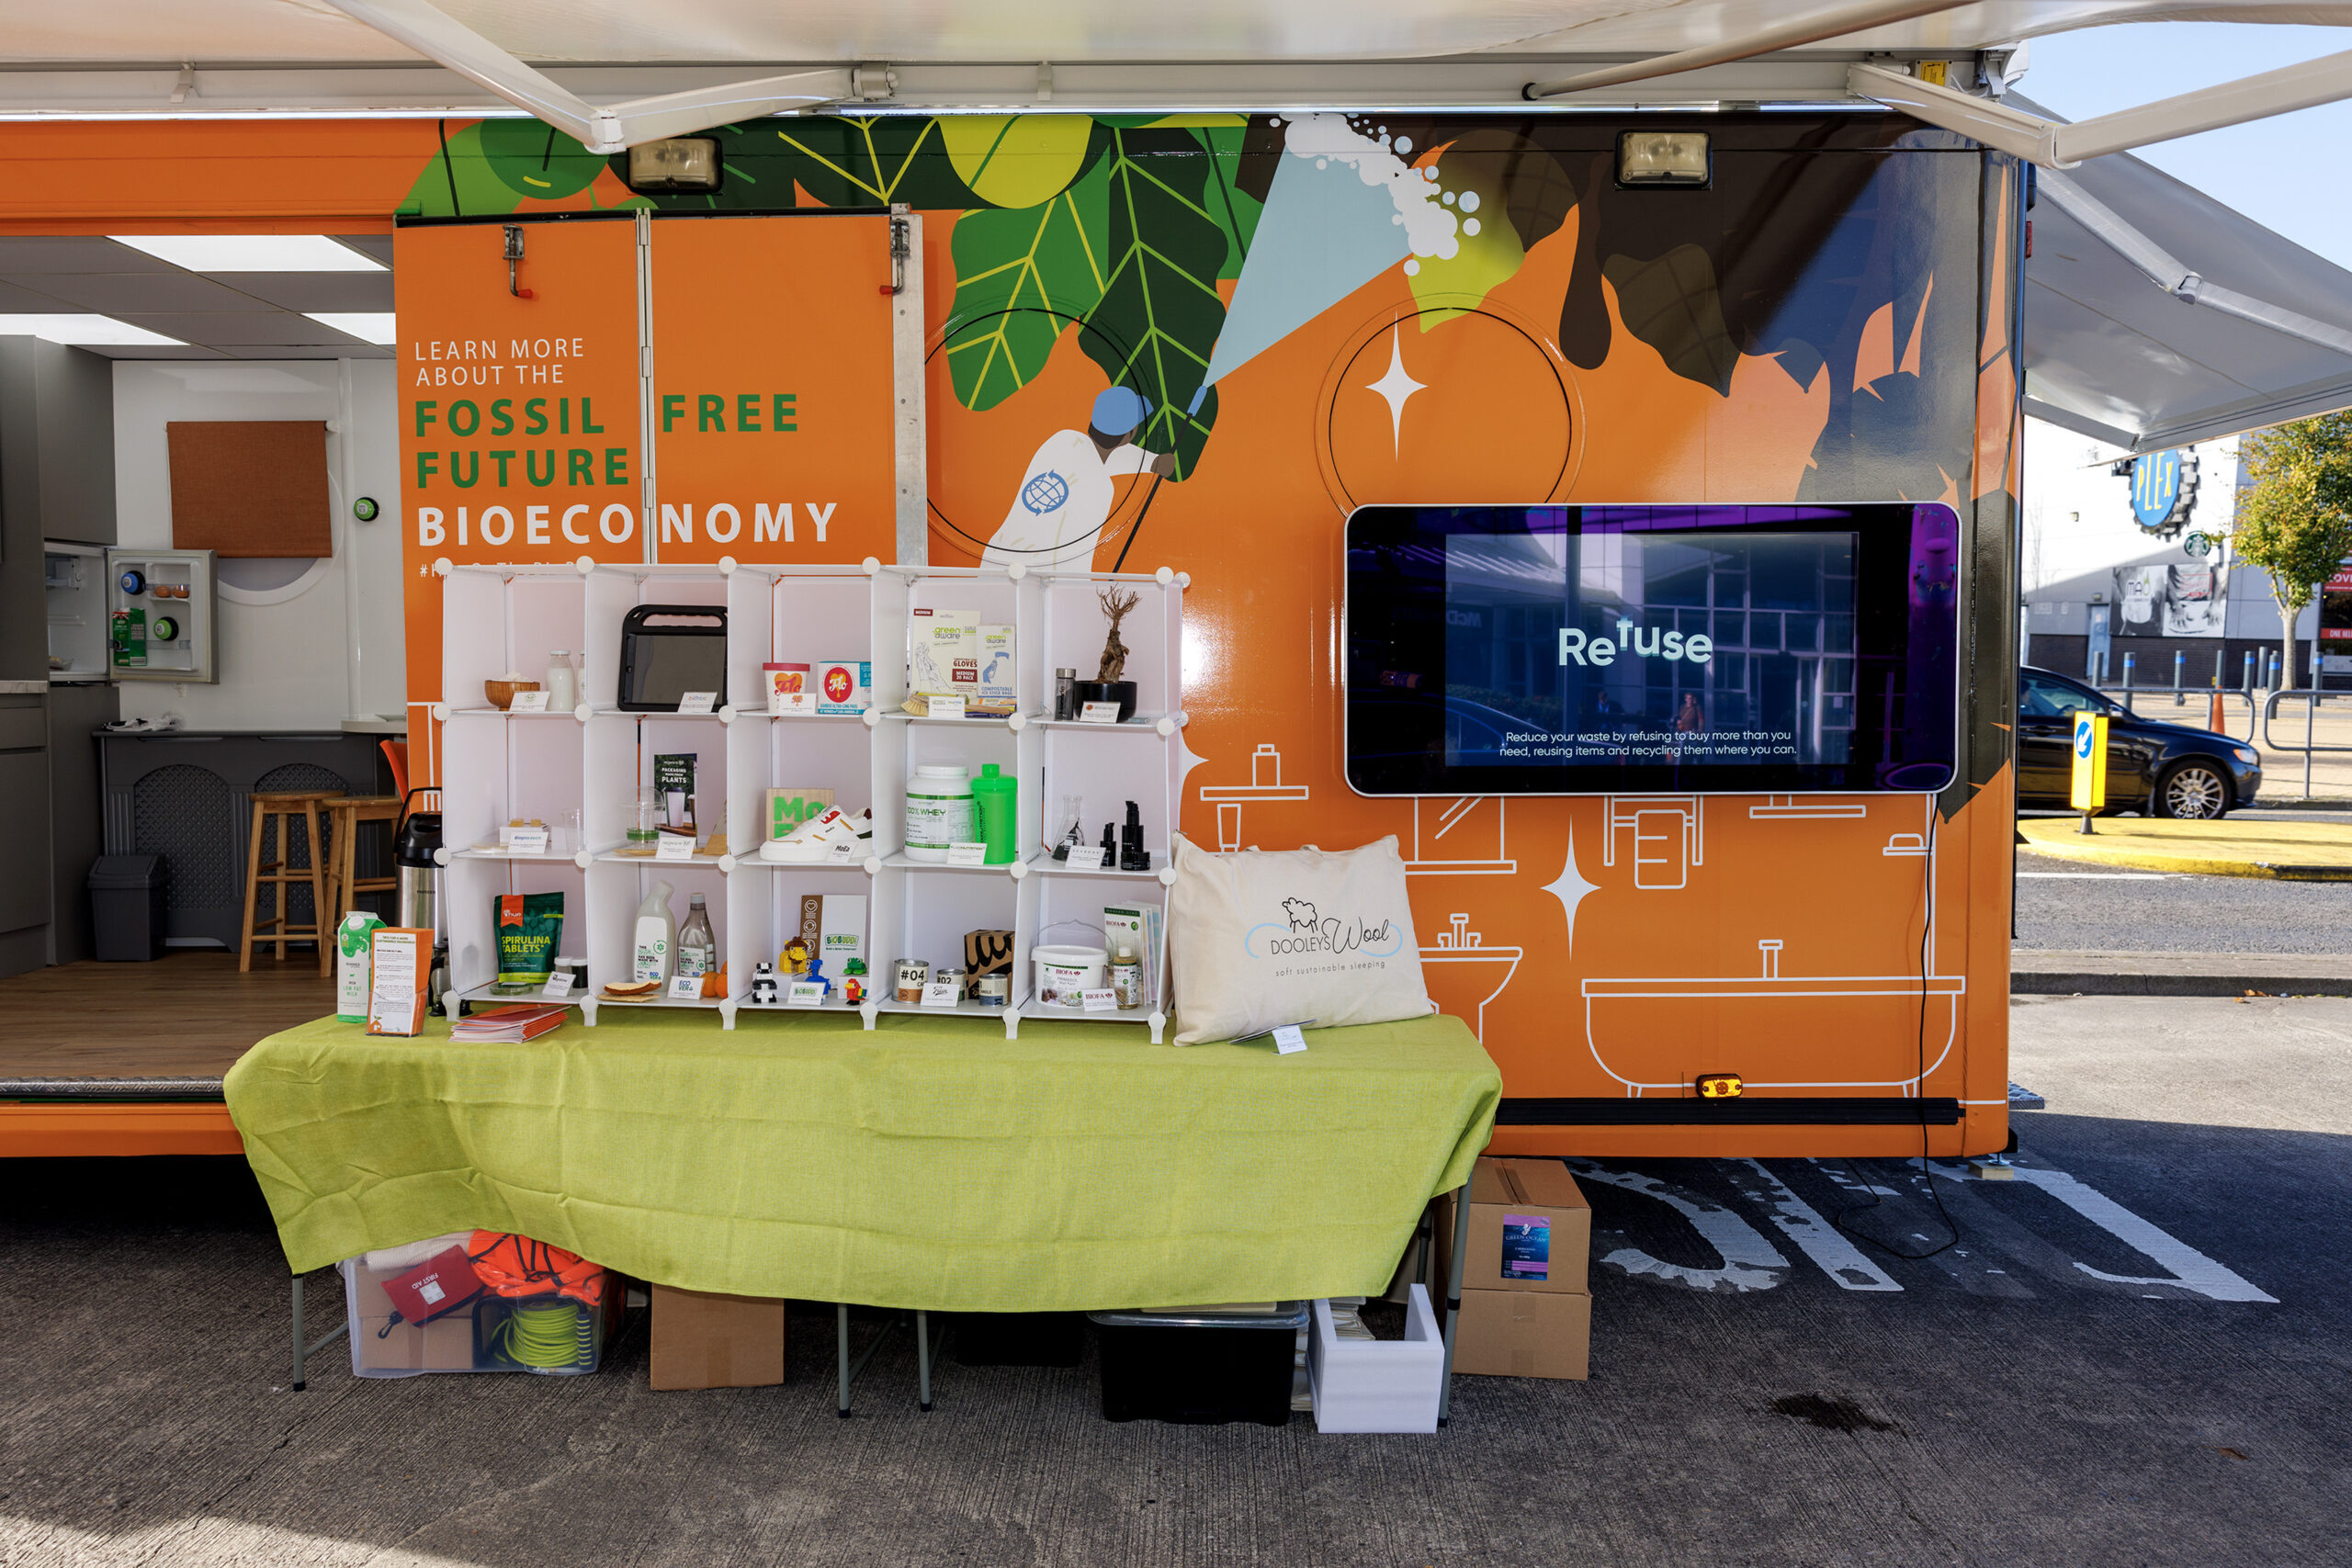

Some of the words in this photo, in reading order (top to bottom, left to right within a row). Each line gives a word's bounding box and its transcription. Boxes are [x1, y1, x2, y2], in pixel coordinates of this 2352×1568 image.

[415, 341, 497, 361] LEARN
[511, 338, 584, 358] MORE
[416, 365, 503, 387] ABOUT
[515, 364, 564, 384] THE
[416, 397, 605, 437] FOSSIL
[662, 394, 798, 433] FREE
[417, 448, 629, 489] FUTURE
[419, 502, 837, 547] BIOECONOMY
[933, 626, 961, 635] green
[1559, 615, 1713, 666] Refuse
[829, 675, 848, 692] Flo
[1506, 731, 1548, 742] Reduce
[1550, 733, 1574, 744] your
[1577, 732, 1610, 741] waste
[1612, 731, 1626, 744] by
[1629, 730, 1671, 743] refusing
[1675, 731, 1686, 741] to
[1689, 730, 1709, 742] buy
[1712, 731, 1740, 740] more
[1743, 730, 1768, 740] than
[1770, 731, 1791, 742] you
[1499, 746, 1531, 757] need,
[1533, 746, 1572, 759] reusing
[1576, 746, 1605, 756] items
[1608, 746, 1629, 756] and
[1632, 745, 1680, 758] recycling
[1683, 745, 1712, 755] them
[1714, 745, 1747, 755] where
[1750, 746, 1770, 756] you
[1773, 746, 1797, 755] can.
[920, 807, 946, 817] WHEY
[501, 935, 551, 944] SPIRULINA
[1271, 937, 1330, 954] DOOLEYS
[1321, 917, 1389, 953] Wool
[900, 970, 924, 981] #04
[1275, 967, 1293, 976] soft
[1296, 963, 1345, 975] sustainable
[1350, 961, 1385, 970] sleeping
[412, 1280, 422, 1290] AID
[424, 1272, 438, 1284] FIRST
